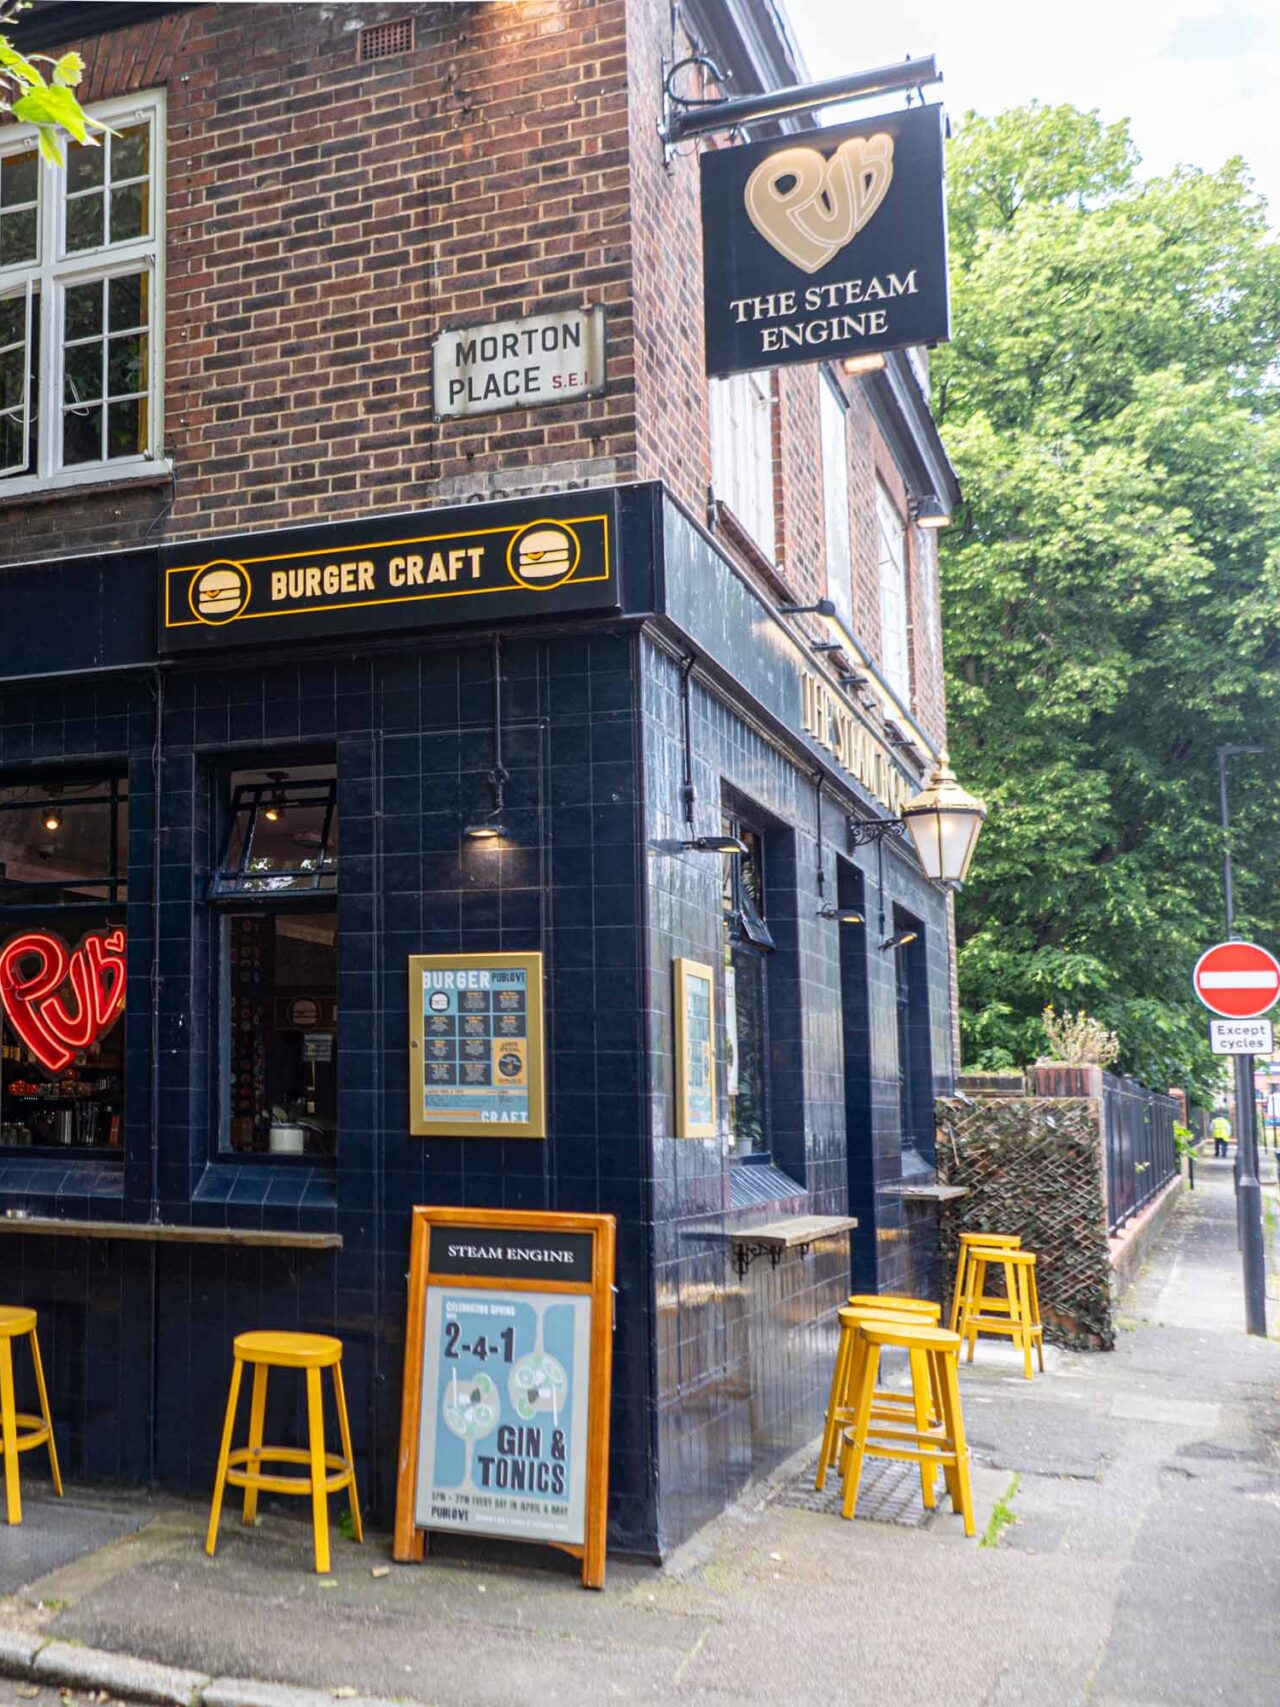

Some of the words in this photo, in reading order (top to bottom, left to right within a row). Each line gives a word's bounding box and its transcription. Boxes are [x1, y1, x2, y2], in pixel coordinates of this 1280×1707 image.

[730, 291, 797, 323] THE
[805, 270, 919, 311] STEAM
[455, 322, 580, 367] MORTON
[760, 310, 888, 352] ENGINE
[449, 366, 540, 405] PLACE
[271, 560, 375, 601] BURGER
[389, 547, 485, 588] CRAFT
[423, 970, 491, 989] BURGER
[1217, 1025, 1266, 1037] Except
[1220, 1037, 1264, 1049] cycles
[481, 1110, 528, 1123] CRAFT
[448, 1245, 503, 1260] STEAM
[506, 1248, 574, 1264] ENGINE
[444, 1322, 515, 1363] 2-4-1
[497, 1425, 541, 1459] GIN
[551, 1430, 566, 1461] &
[478, 1455, 565, 1496] TONICS
[472, 1496, 492, 1507] EVERY
[495, 1498, 507, 1509] DAY
[521, 1502, 541, 1514] APRIL
[551, 1505, 568, 1516] MAY
